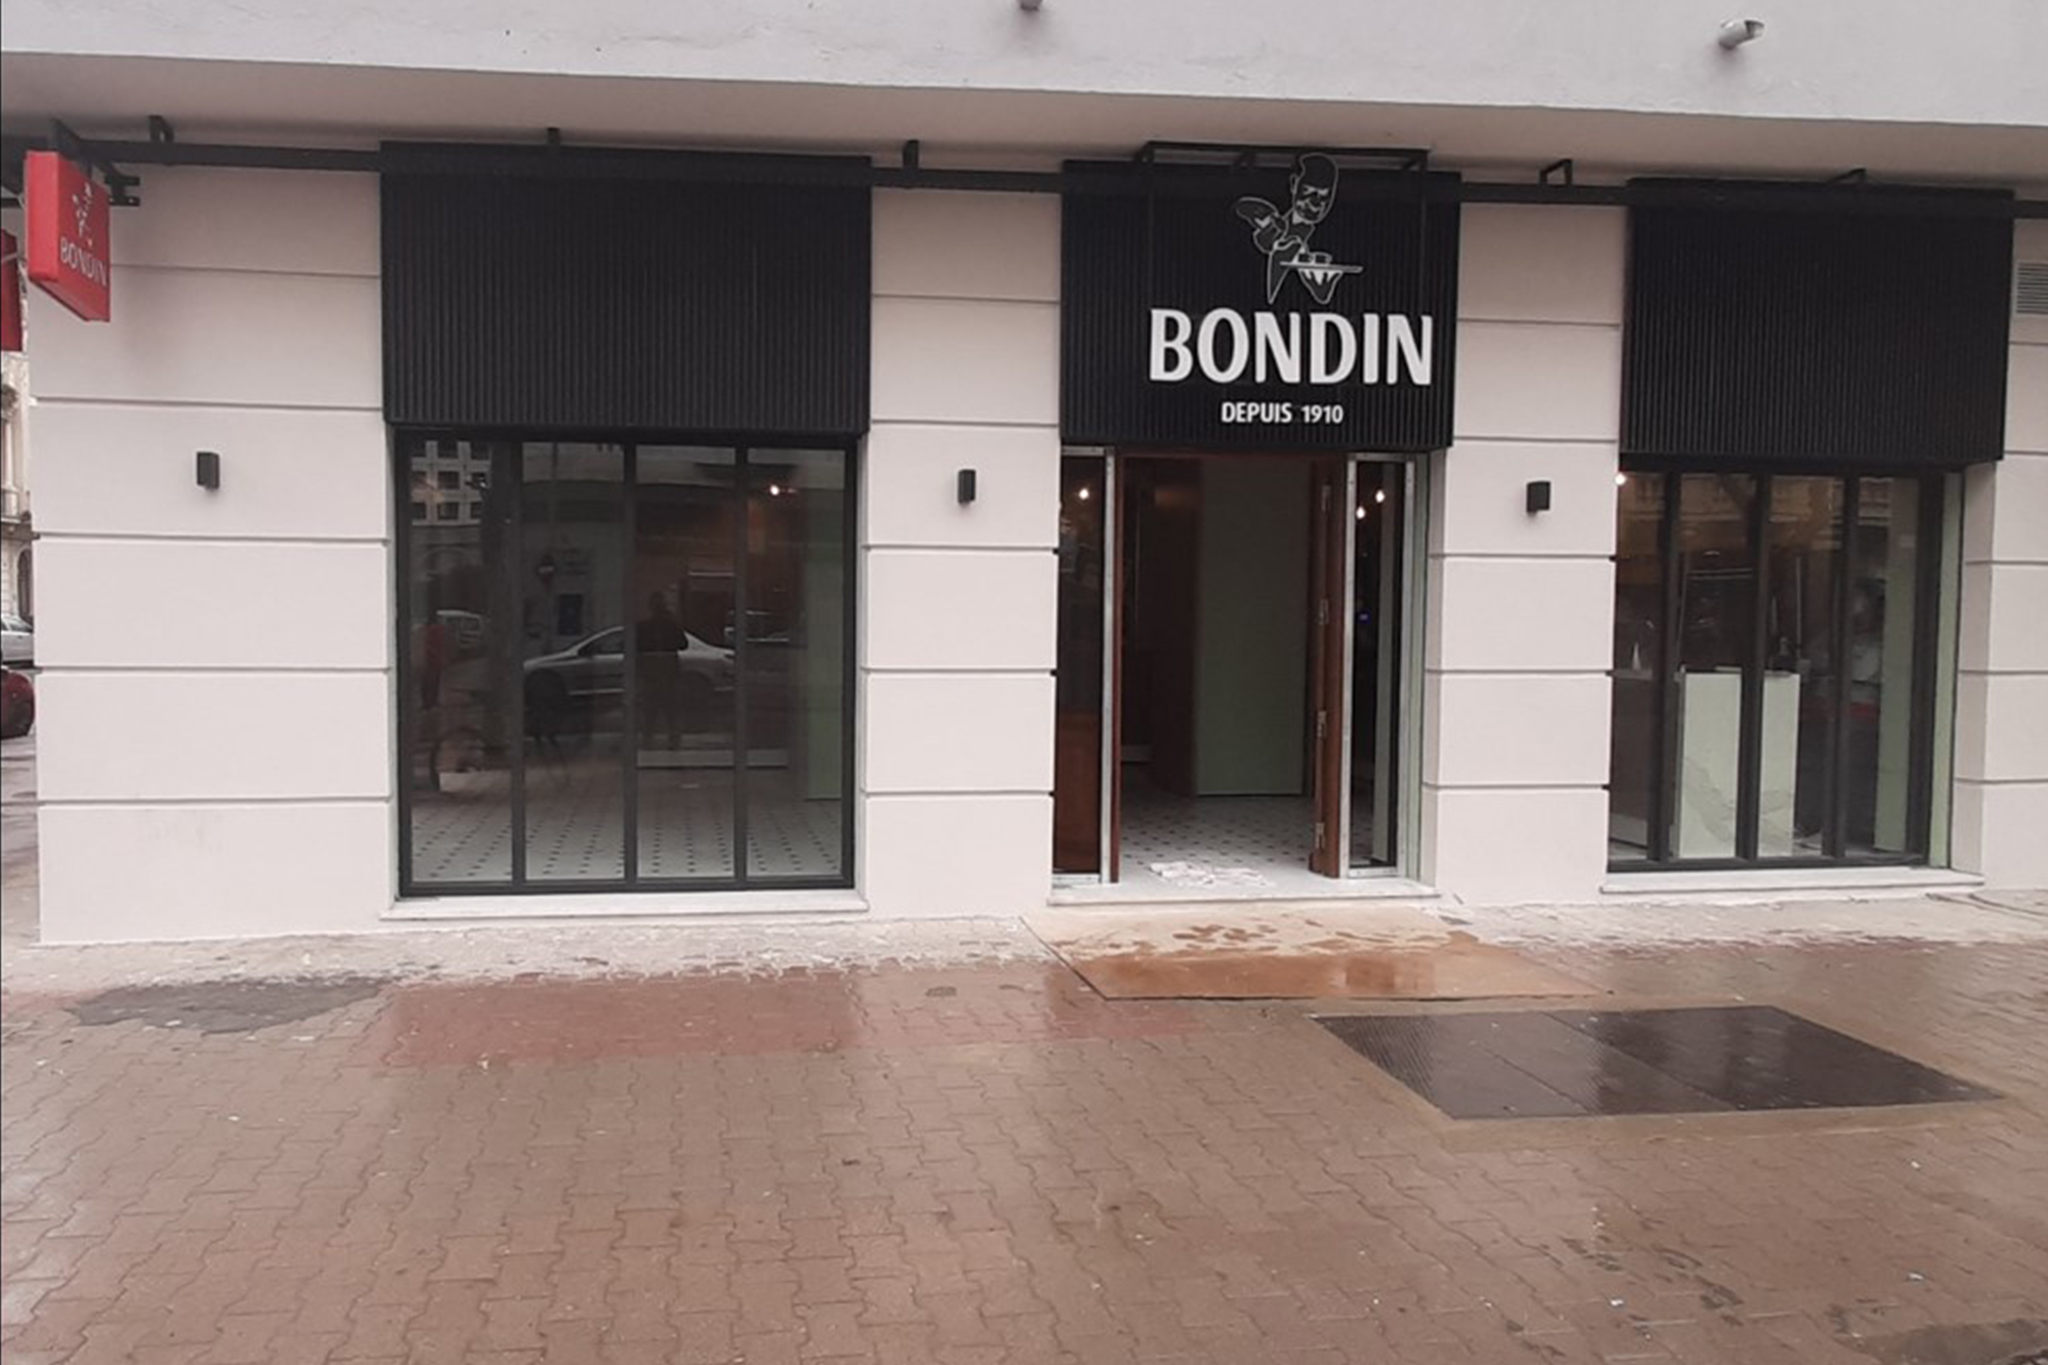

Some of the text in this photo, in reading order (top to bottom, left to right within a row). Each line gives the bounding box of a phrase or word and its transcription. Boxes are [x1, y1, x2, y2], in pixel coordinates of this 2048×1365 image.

[60, 237, 107, 287] BONDIN
[1149, 308, 1433, 386] BONDIN
[1221, 402, 1343, 424] DEPUIS 1910
